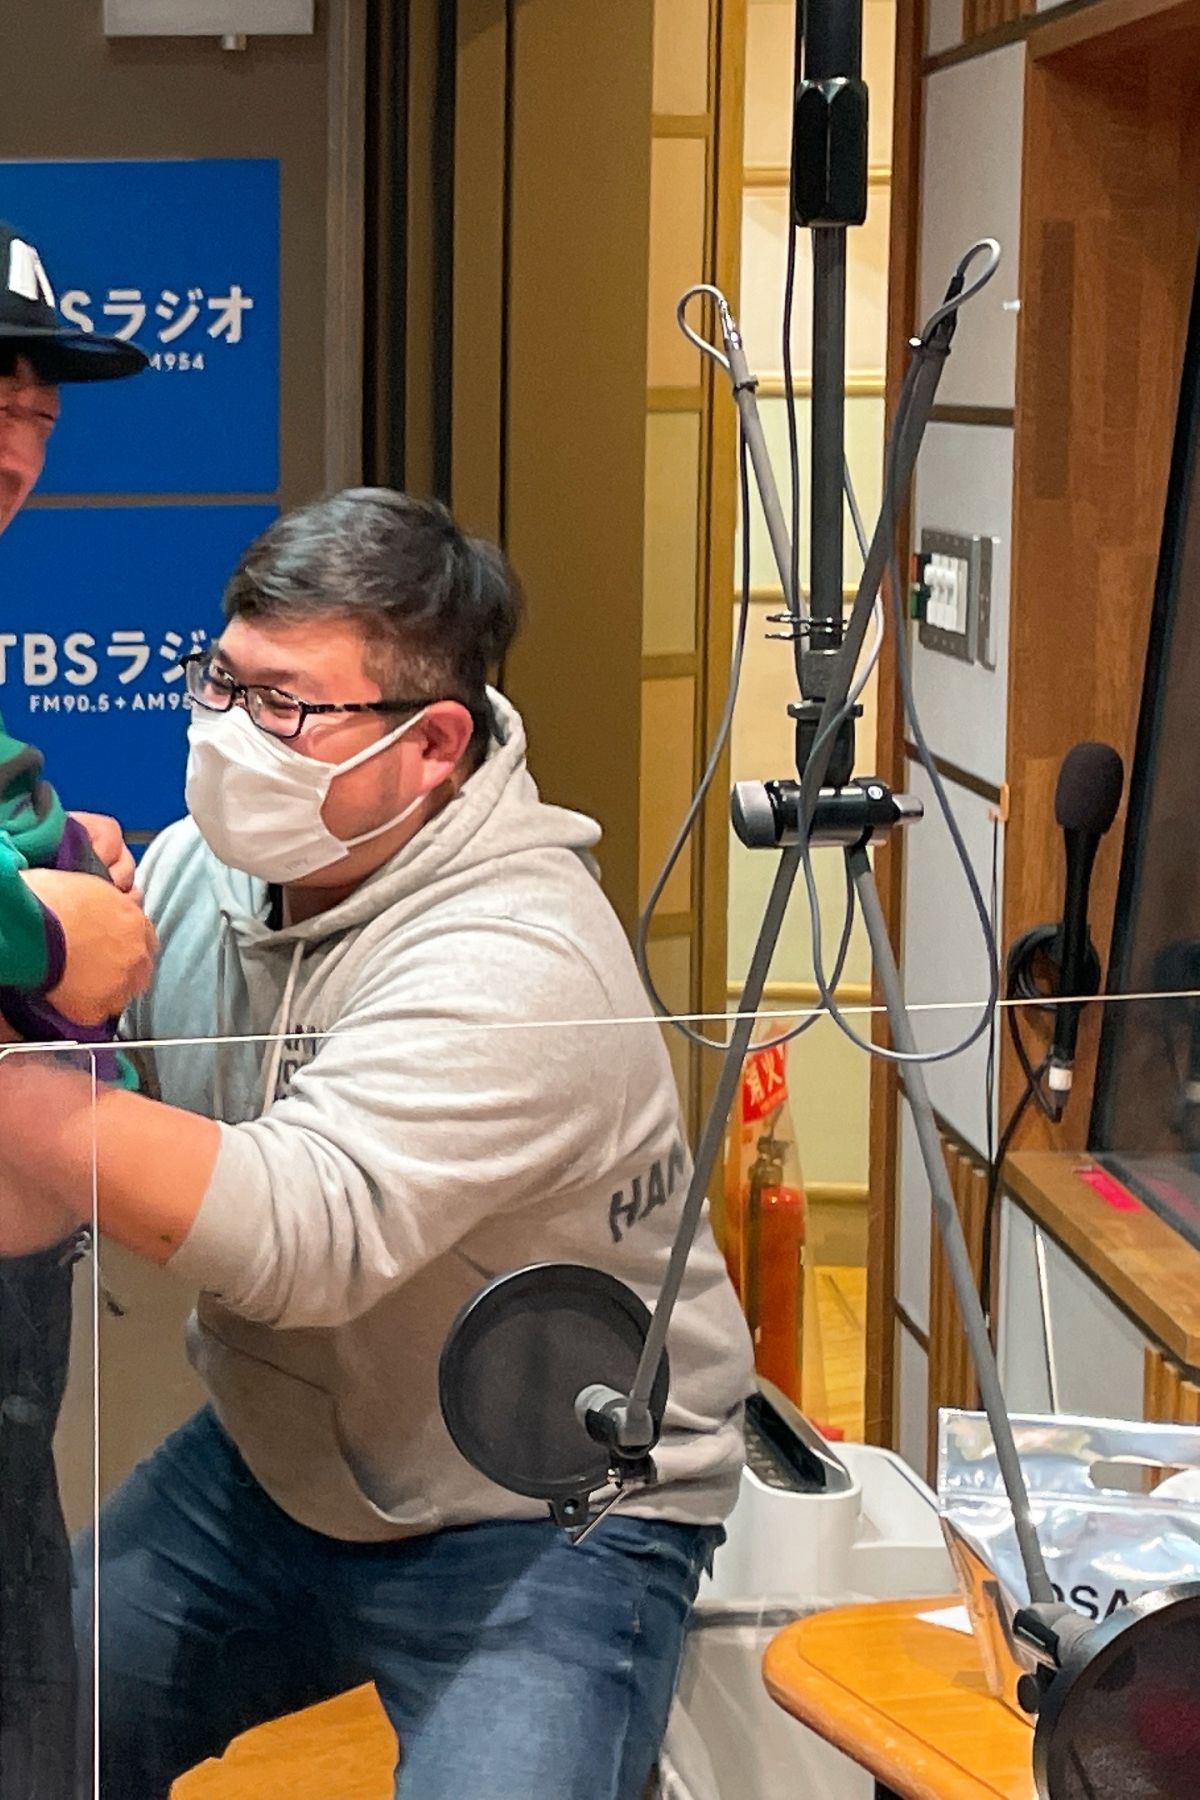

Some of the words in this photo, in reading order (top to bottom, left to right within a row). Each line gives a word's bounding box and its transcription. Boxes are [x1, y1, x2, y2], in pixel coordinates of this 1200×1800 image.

[60, 285, 253, 343] Sラジオ
[29, 692, 192, 712] FM90.5+AM95
[745, 1043, 785, 1106] 消火
[1050, 1583, 1149, 1620] SA
